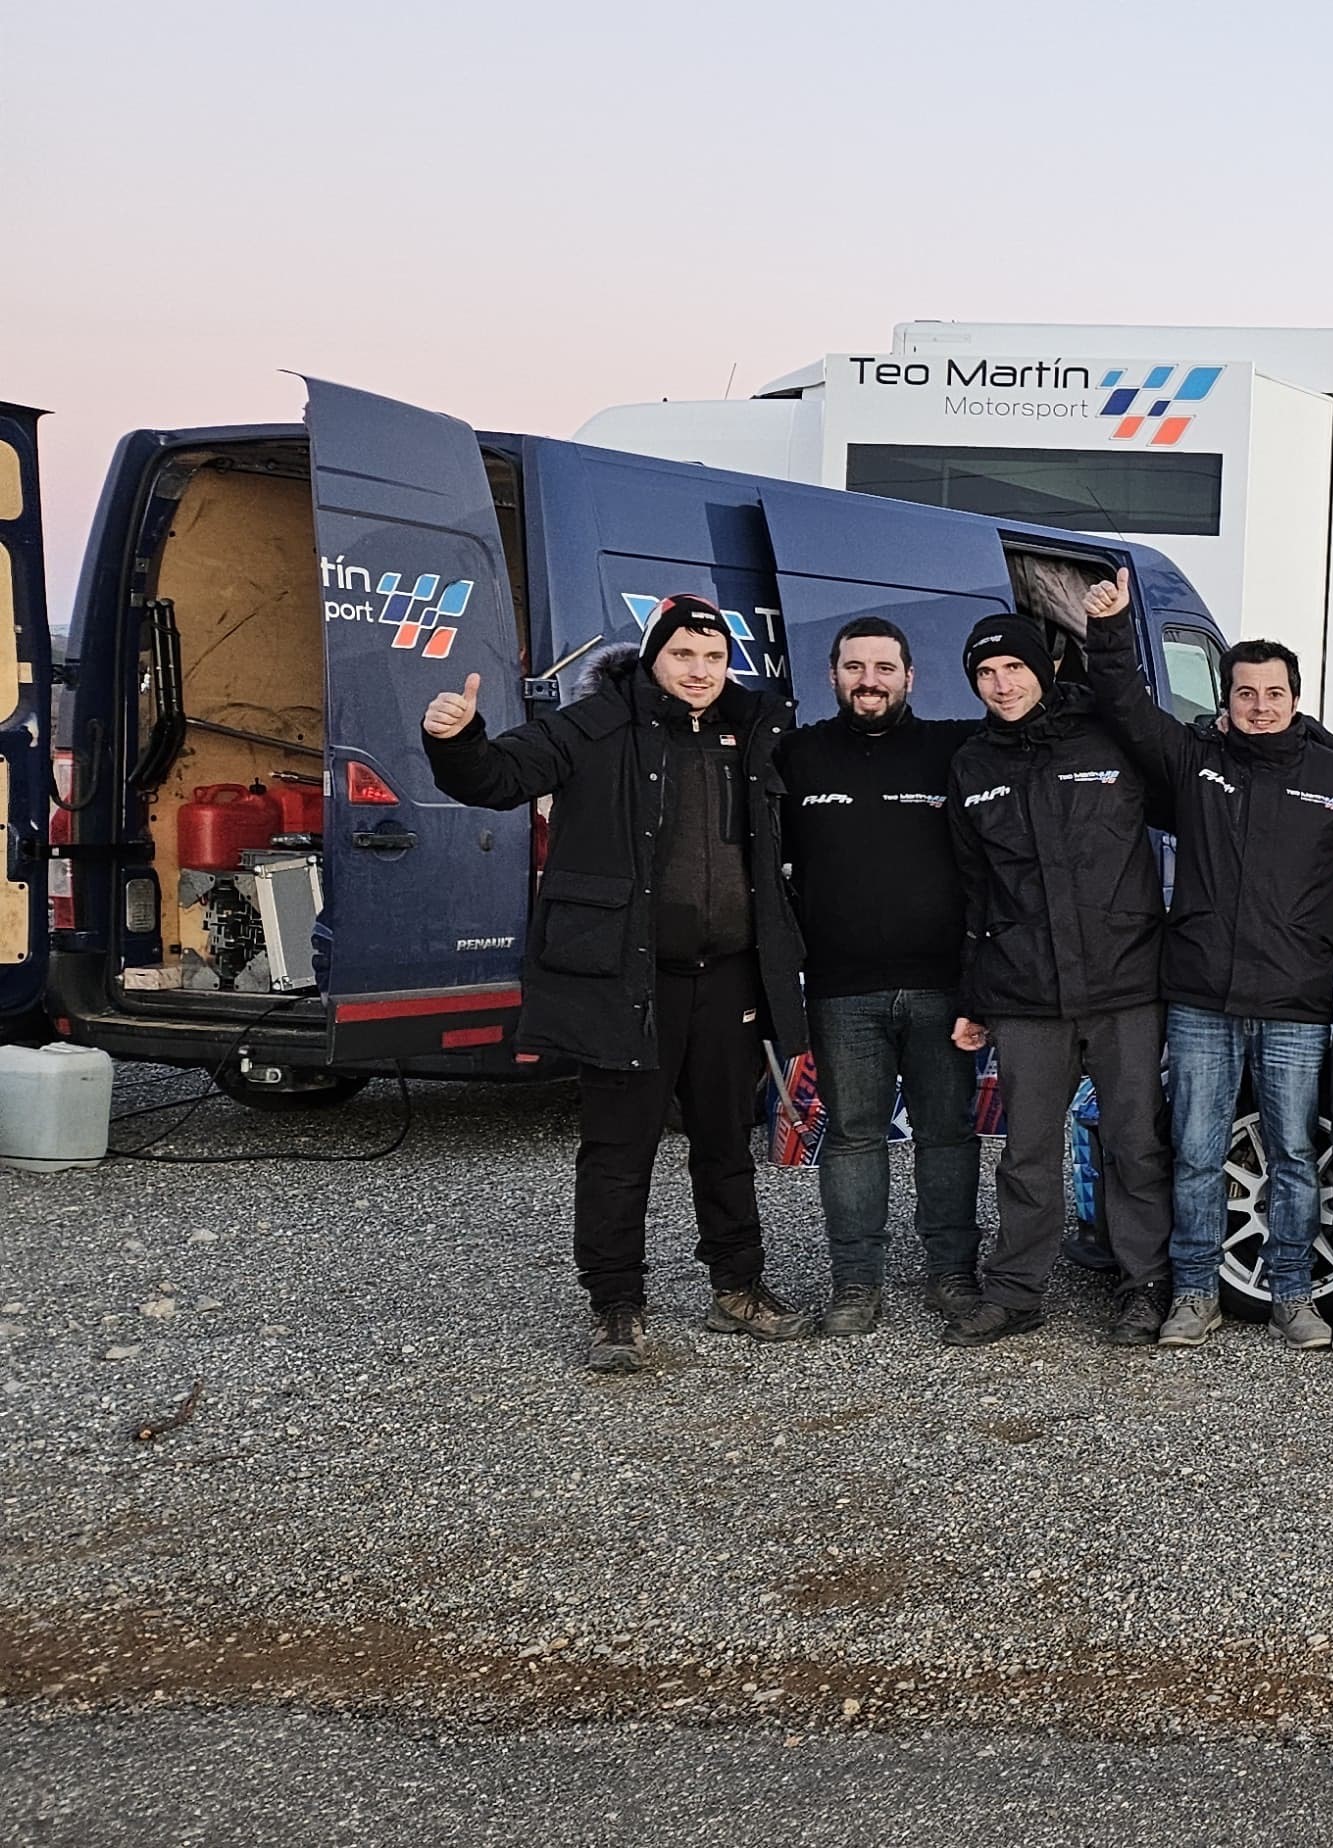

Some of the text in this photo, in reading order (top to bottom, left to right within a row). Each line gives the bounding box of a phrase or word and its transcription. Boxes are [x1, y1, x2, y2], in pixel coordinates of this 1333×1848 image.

[849, 357, 1089, 389] Teo Martín
[944, 396, 1089, 420] Motorsport
[324, 601, 374, 623] port
[456, 937, 515, 951] RENAULT
